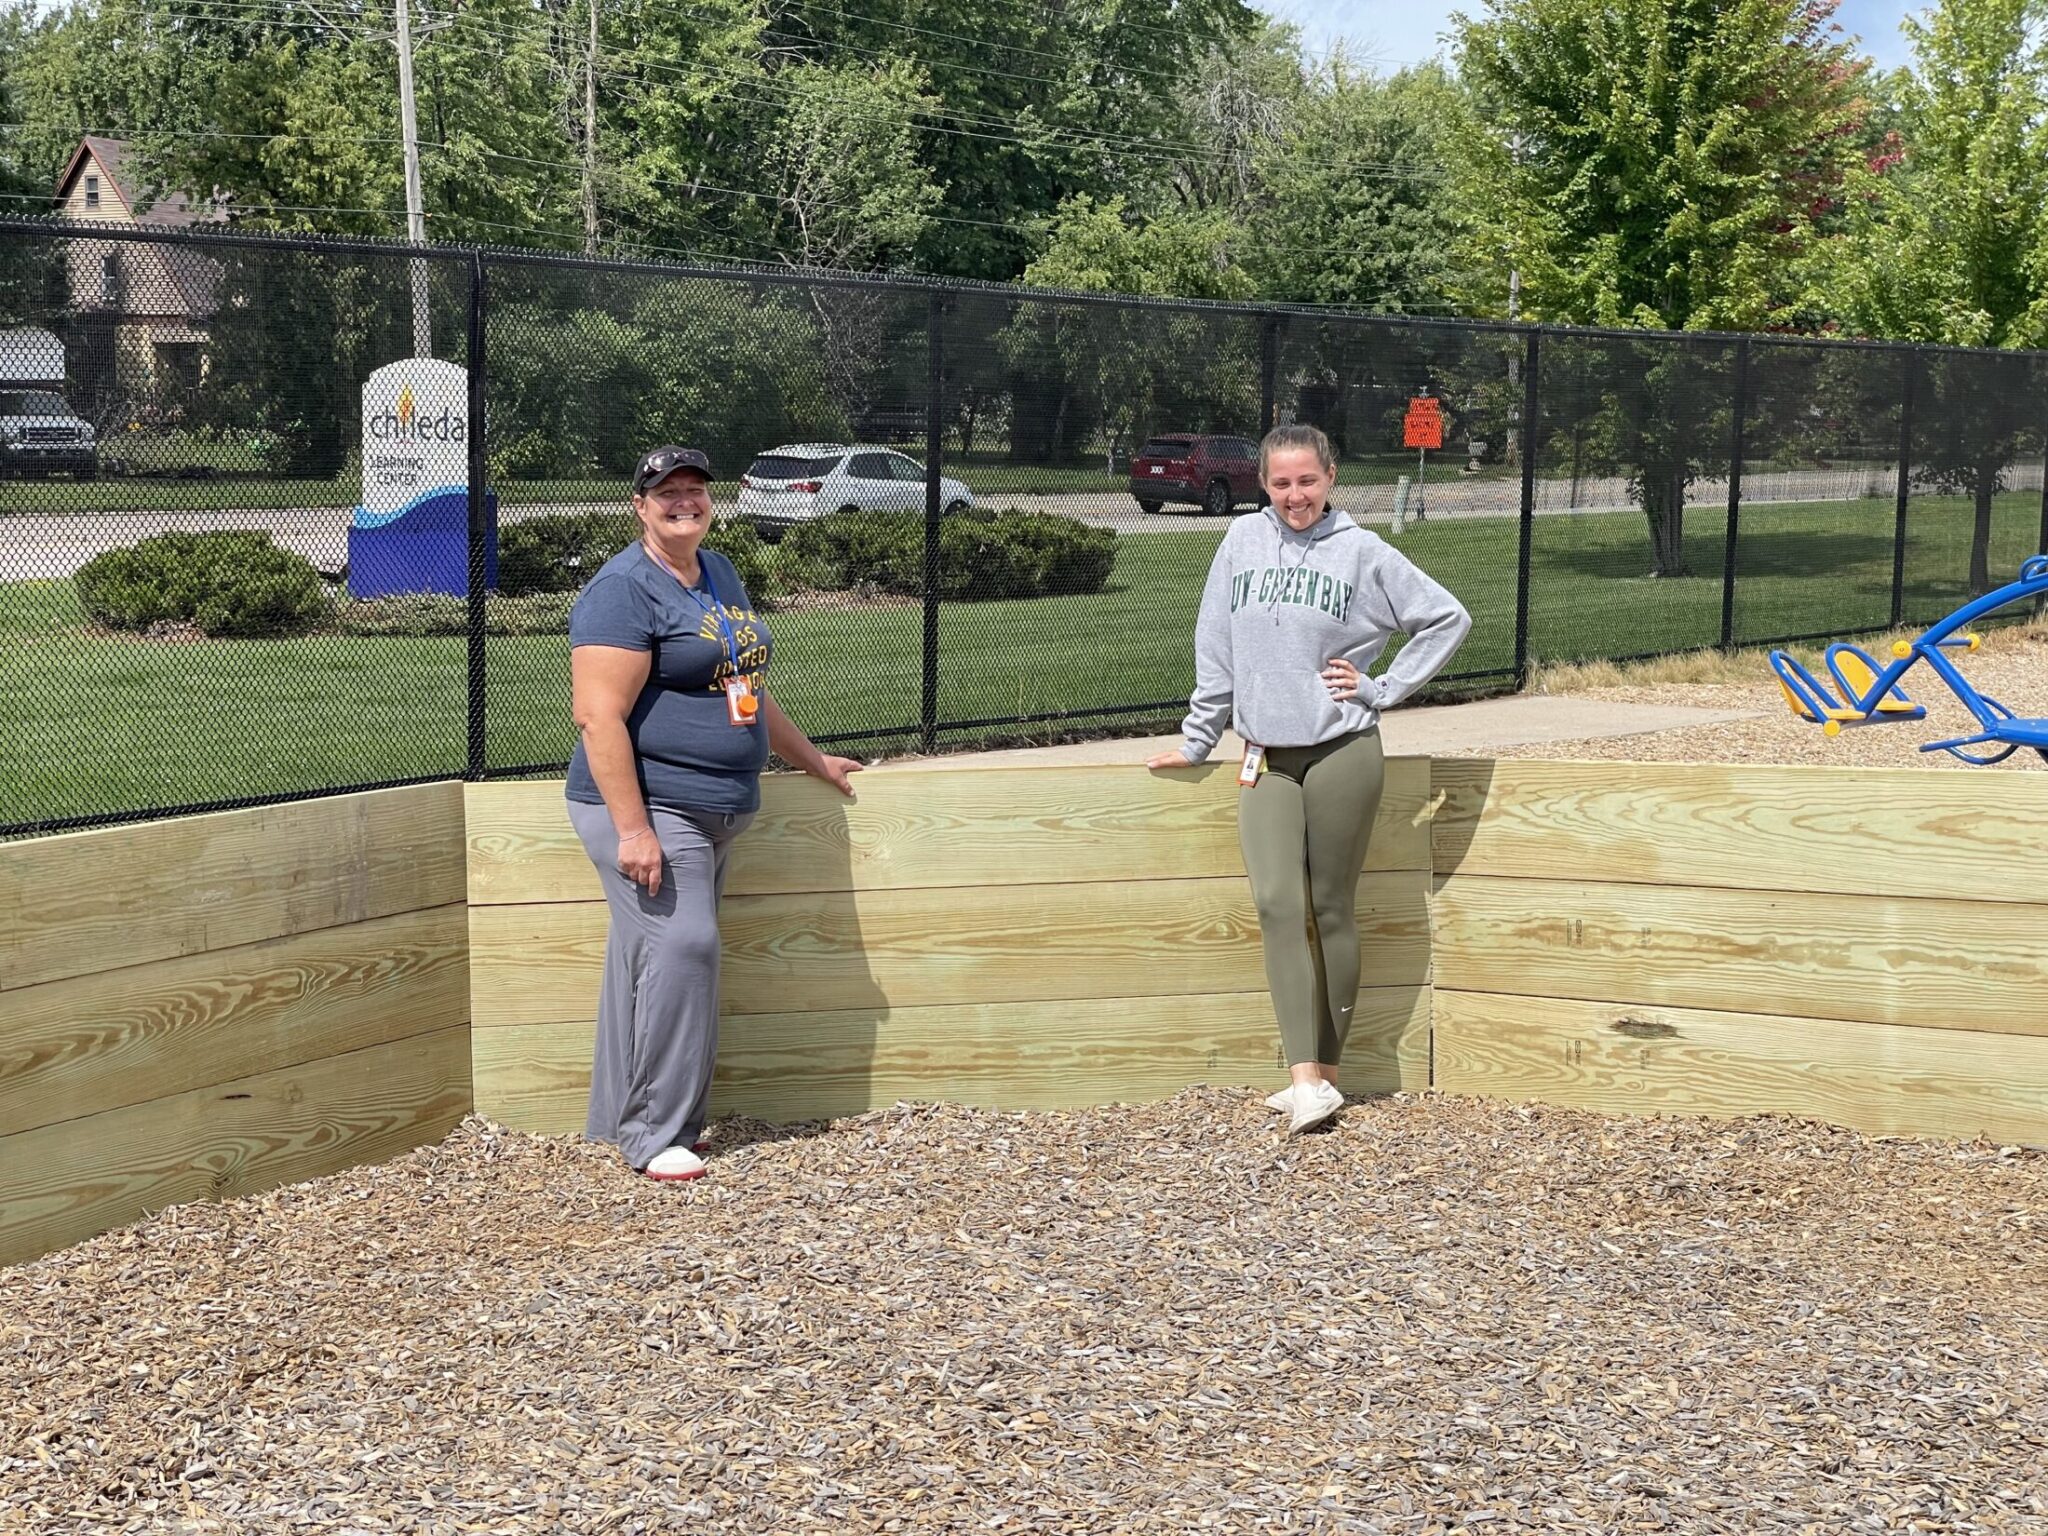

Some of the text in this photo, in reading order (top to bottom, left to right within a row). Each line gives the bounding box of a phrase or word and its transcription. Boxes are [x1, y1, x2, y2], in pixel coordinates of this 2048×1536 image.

[369, 456, 424, 470] LEARNING
[376, 471, 418, 486] CENTER
[1319, 573, 1353, 624] BAY
